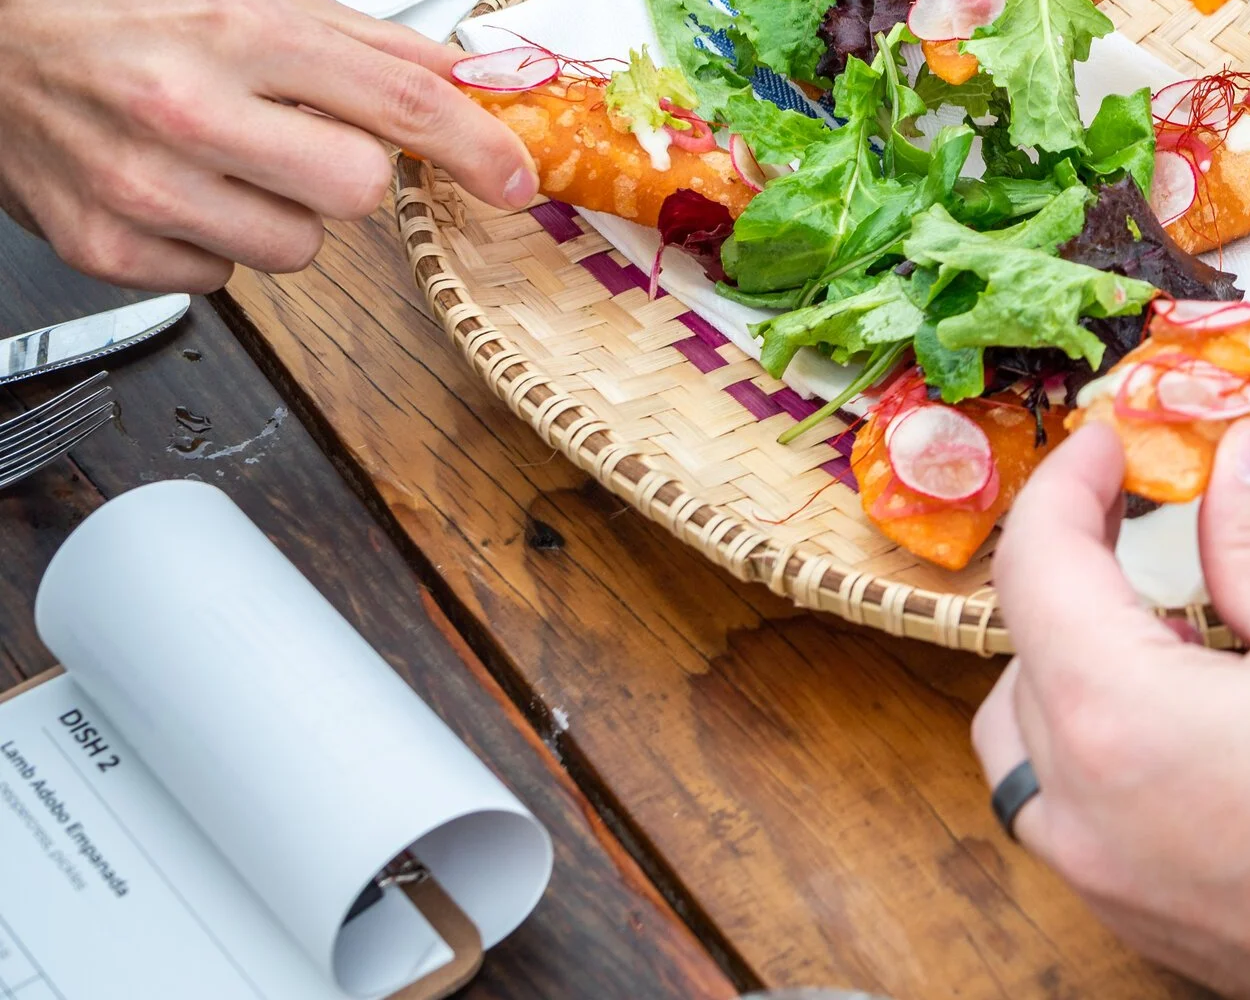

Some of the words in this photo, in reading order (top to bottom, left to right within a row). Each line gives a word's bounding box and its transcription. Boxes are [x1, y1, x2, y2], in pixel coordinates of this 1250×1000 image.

[57, 708, 109, 757] DISH
[96, 754, 121, 773] 2
[0, 739, 36, 780] Lamb
[30, 779, 70, 824] Adobo
[65, 821, 129, 898] Empanada
